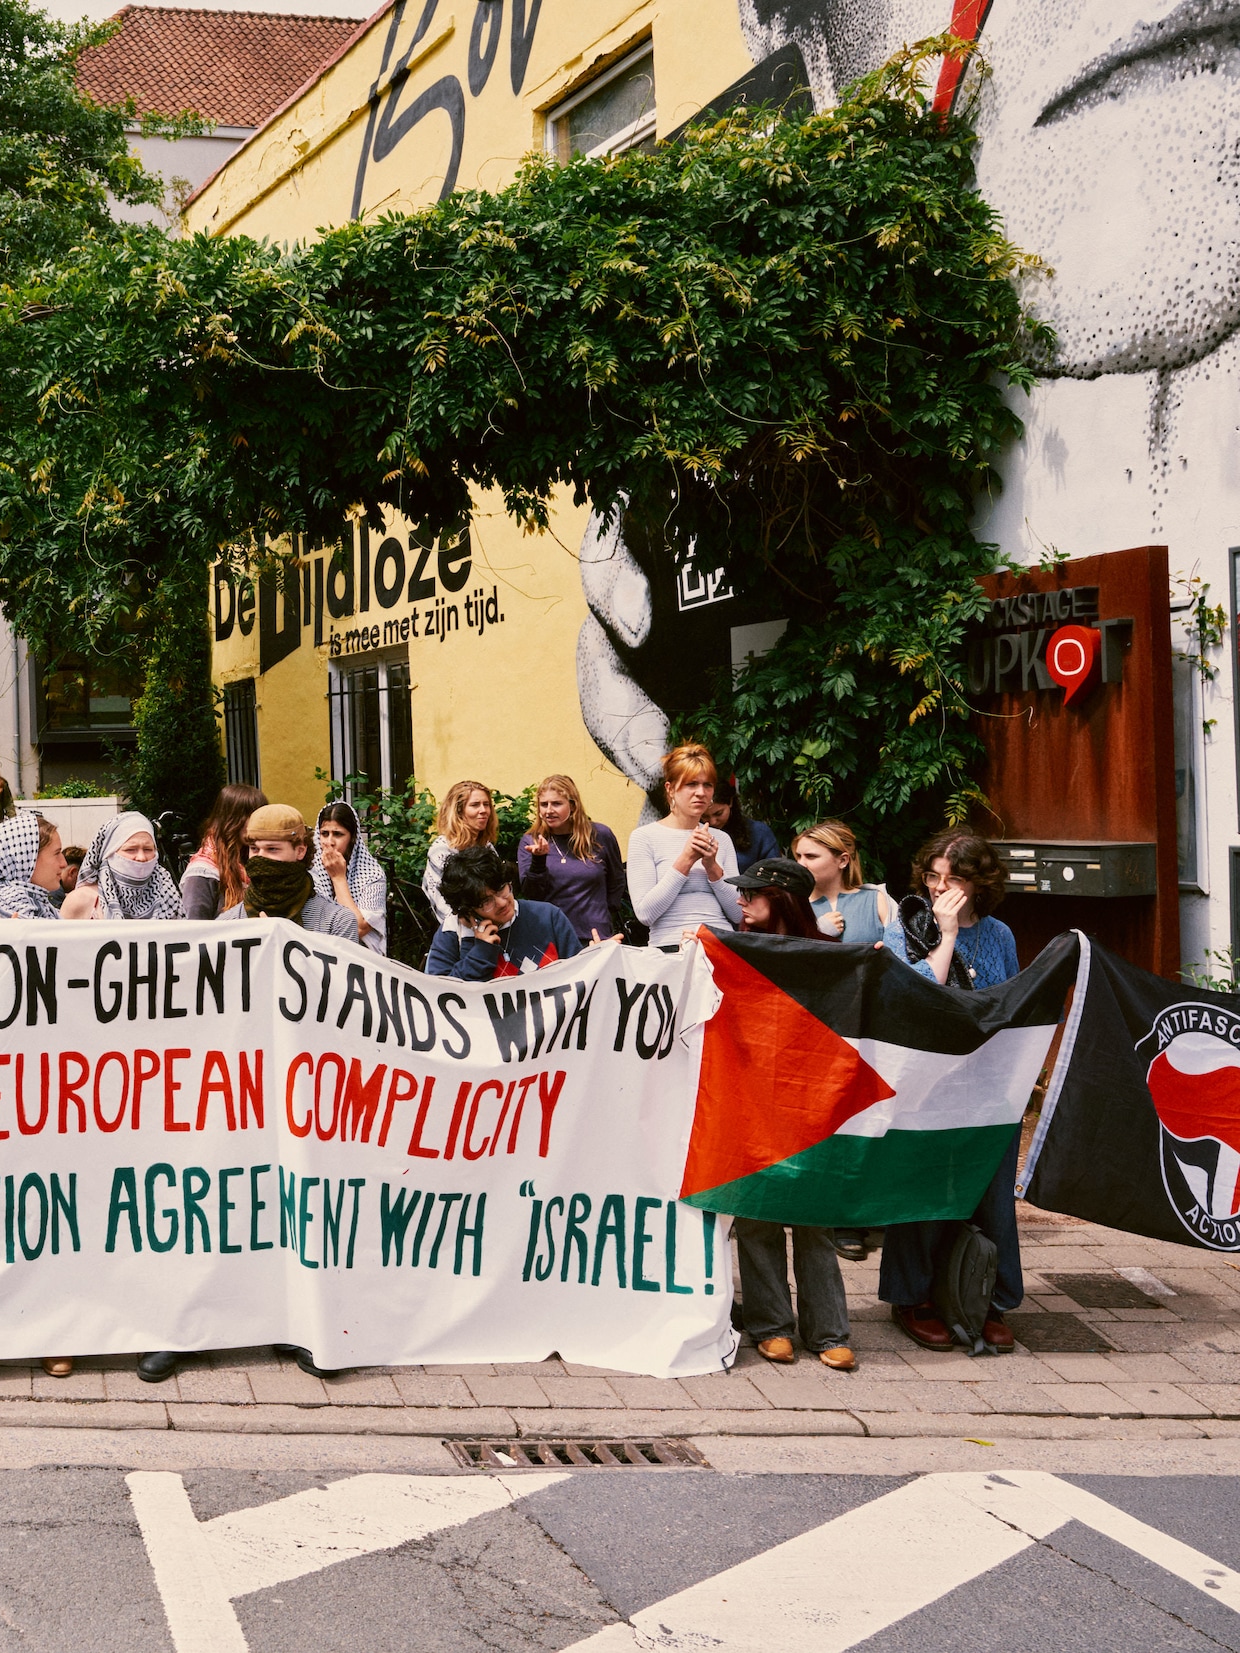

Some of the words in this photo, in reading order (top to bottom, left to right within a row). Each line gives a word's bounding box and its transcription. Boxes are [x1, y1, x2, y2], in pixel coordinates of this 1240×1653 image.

[329, 625, 342, 656] is
[345, 624, 380, 653] mee
[384, 607, 419, 644] met
[425, 597, 459, 642] zijn
[464, 585, 505, 636] tijd.
[991, 586, 1099, 628] CKSTAGE
[279, 940, 472, 1060] STANDS
[483, 979, 599, 1062] WITH
[612, 977, 678, 1060] YOU
[286, 1051, 566, 1161] COMPLICITY
[104, 1162, 365, 1270] AGREEMENT
[380, 1182, 487, 1277] WITH
